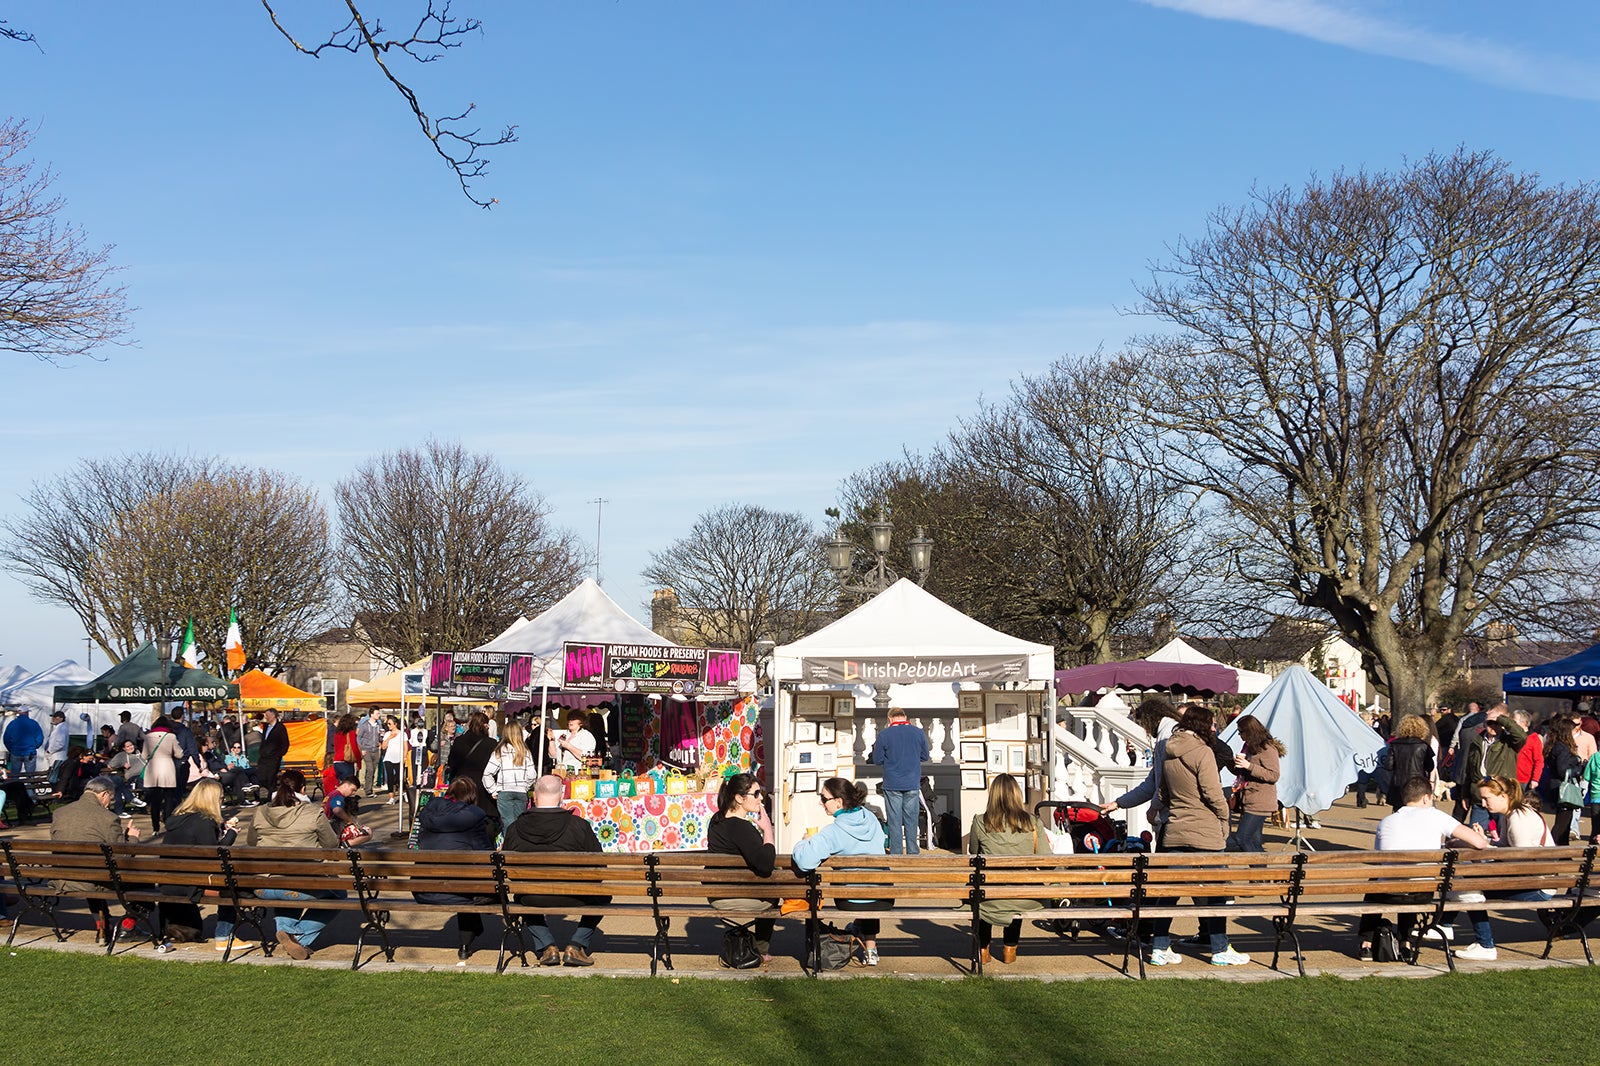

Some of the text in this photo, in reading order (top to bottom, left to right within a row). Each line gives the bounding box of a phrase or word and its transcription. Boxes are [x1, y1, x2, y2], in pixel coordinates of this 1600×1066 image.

[453, 652, 470, 662] ARTISAN
[470, 652, 484, 663] FOODS
[488, 653, 510, 664] PRESERVES
[607, 645, 705, 660] ARTISAN FOODS & PRESERVES
[565, 645, 602, 682] Wild
[708, 652, 739, 686] Wild
[1521, 675, 1600, 688] BRYAN'S CO
